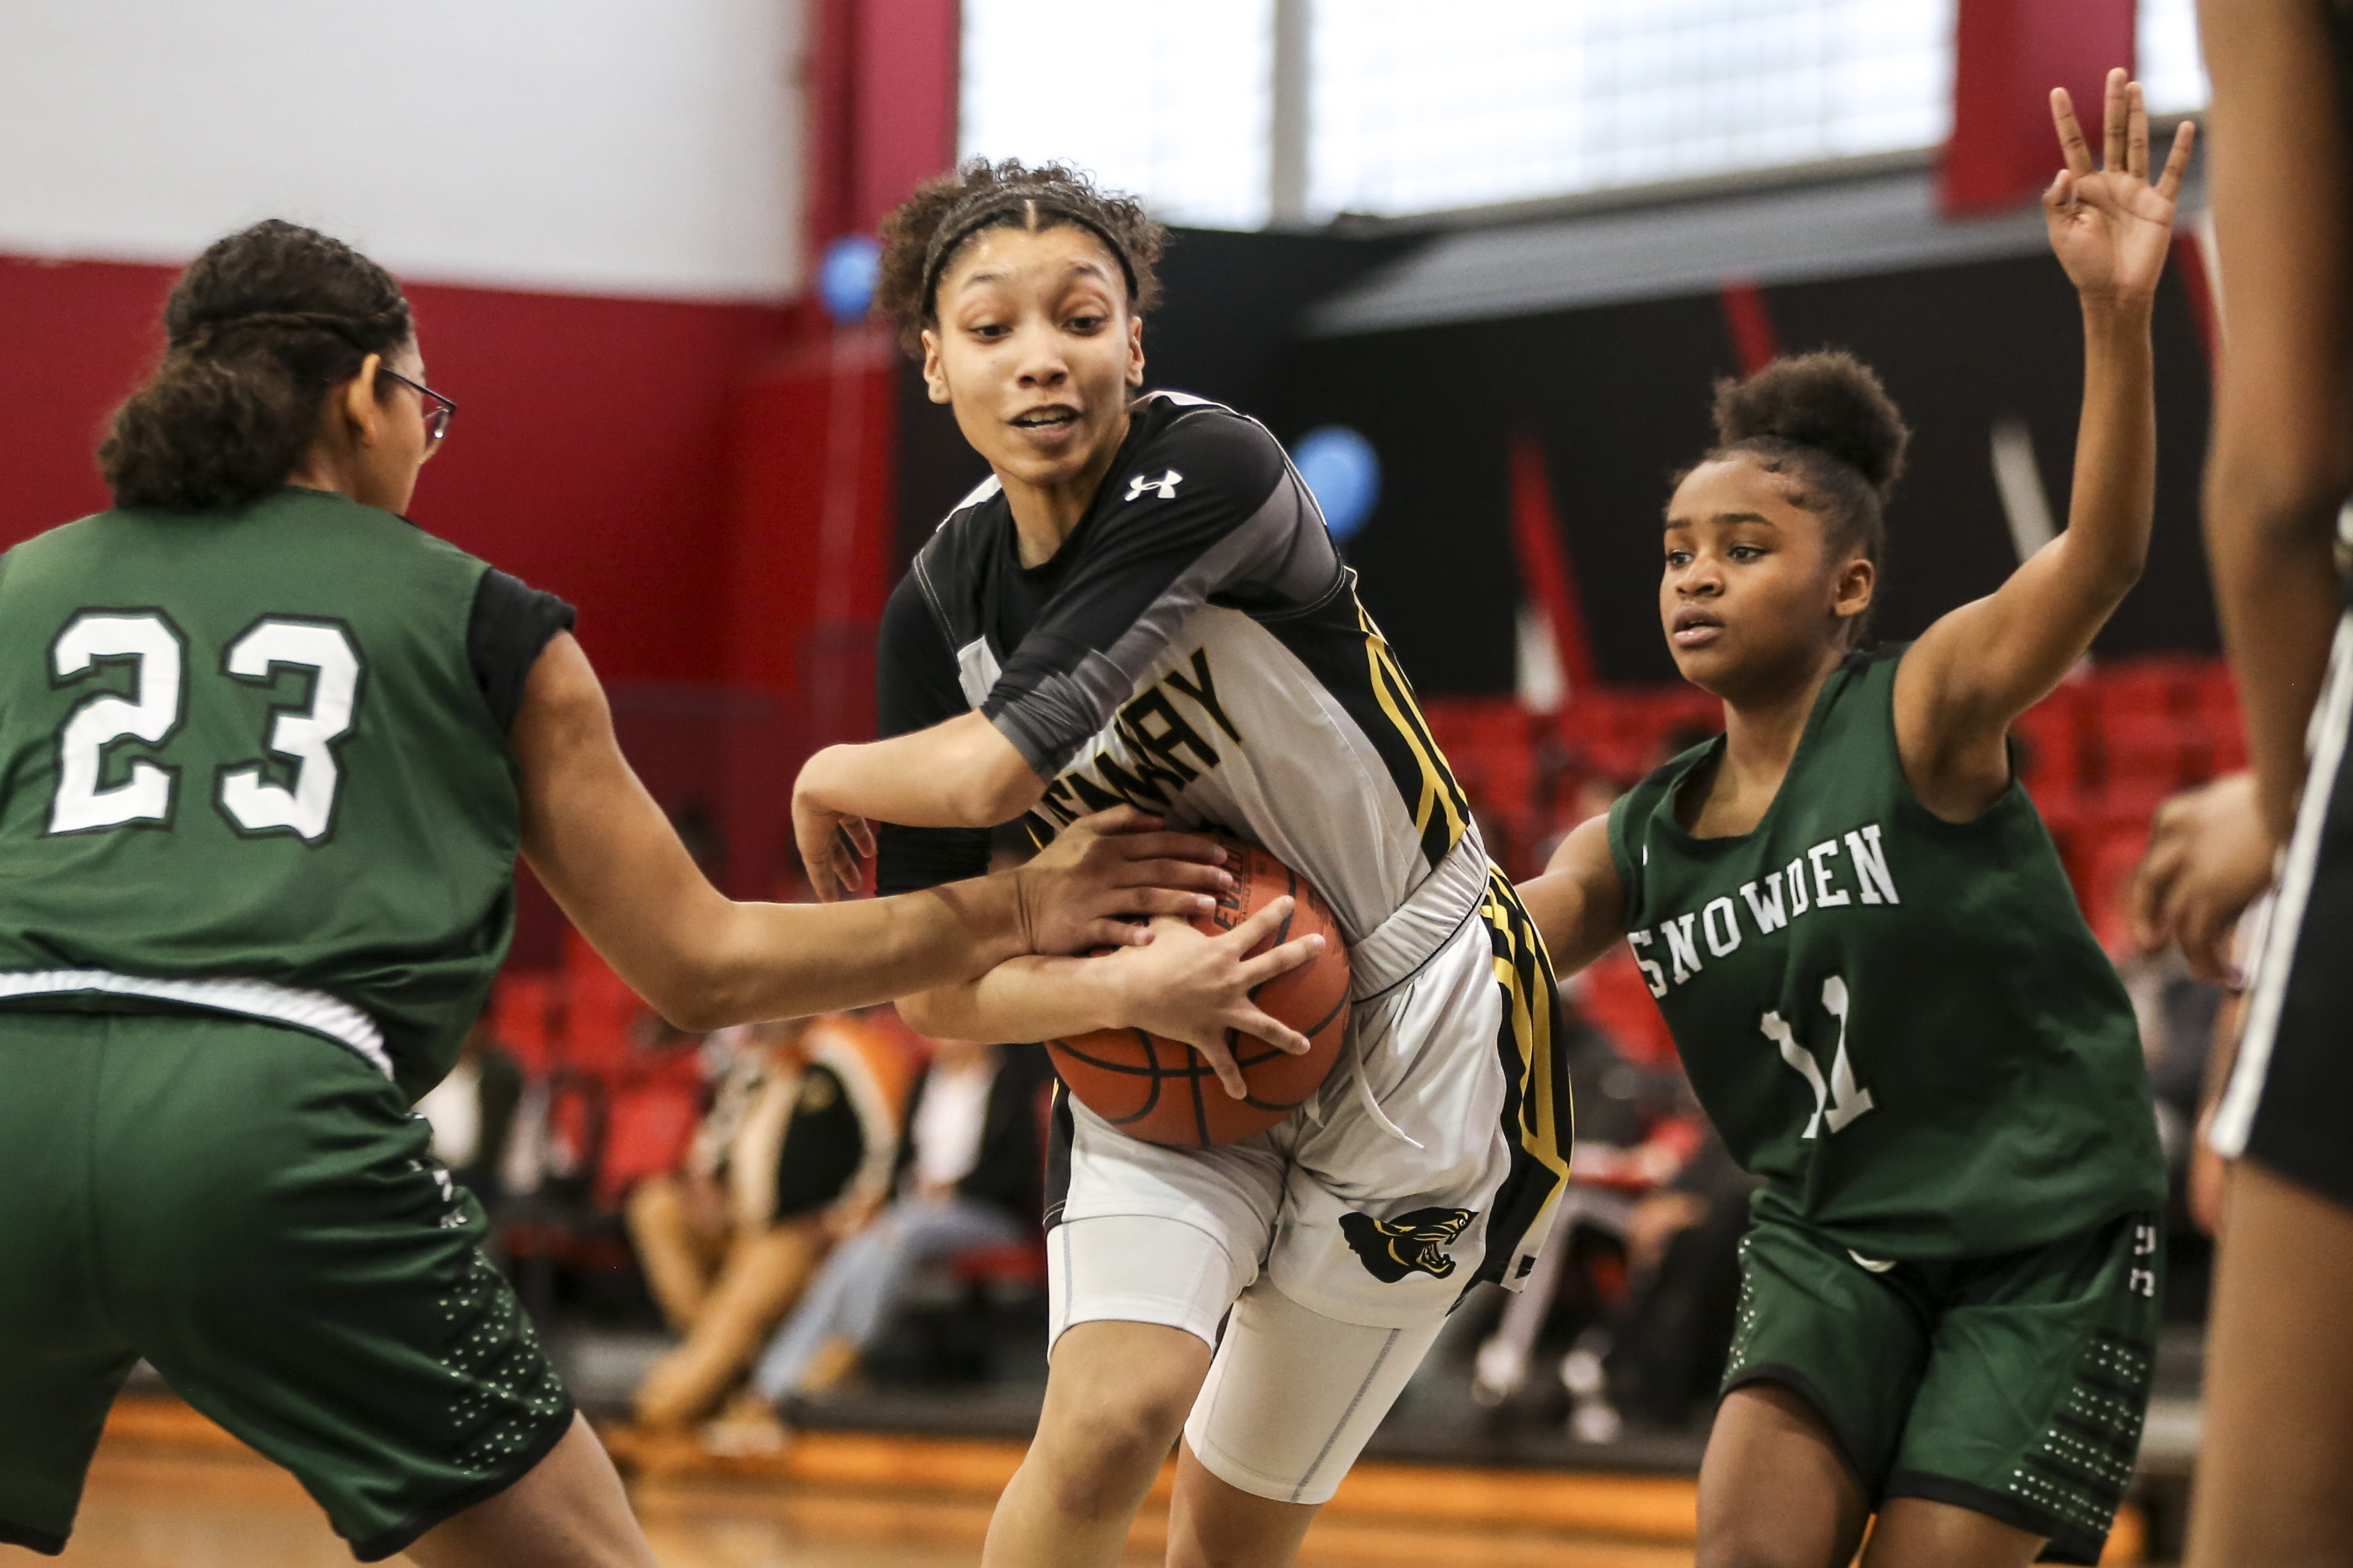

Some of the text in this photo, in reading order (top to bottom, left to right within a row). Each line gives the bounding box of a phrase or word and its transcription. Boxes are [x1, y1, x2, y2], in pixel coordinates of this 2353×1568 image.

[44, 610, 363, 845] 23
[1627, 824, 1901, 998] SNOWDEN
[1760, 974, 1875, 1139] 11
